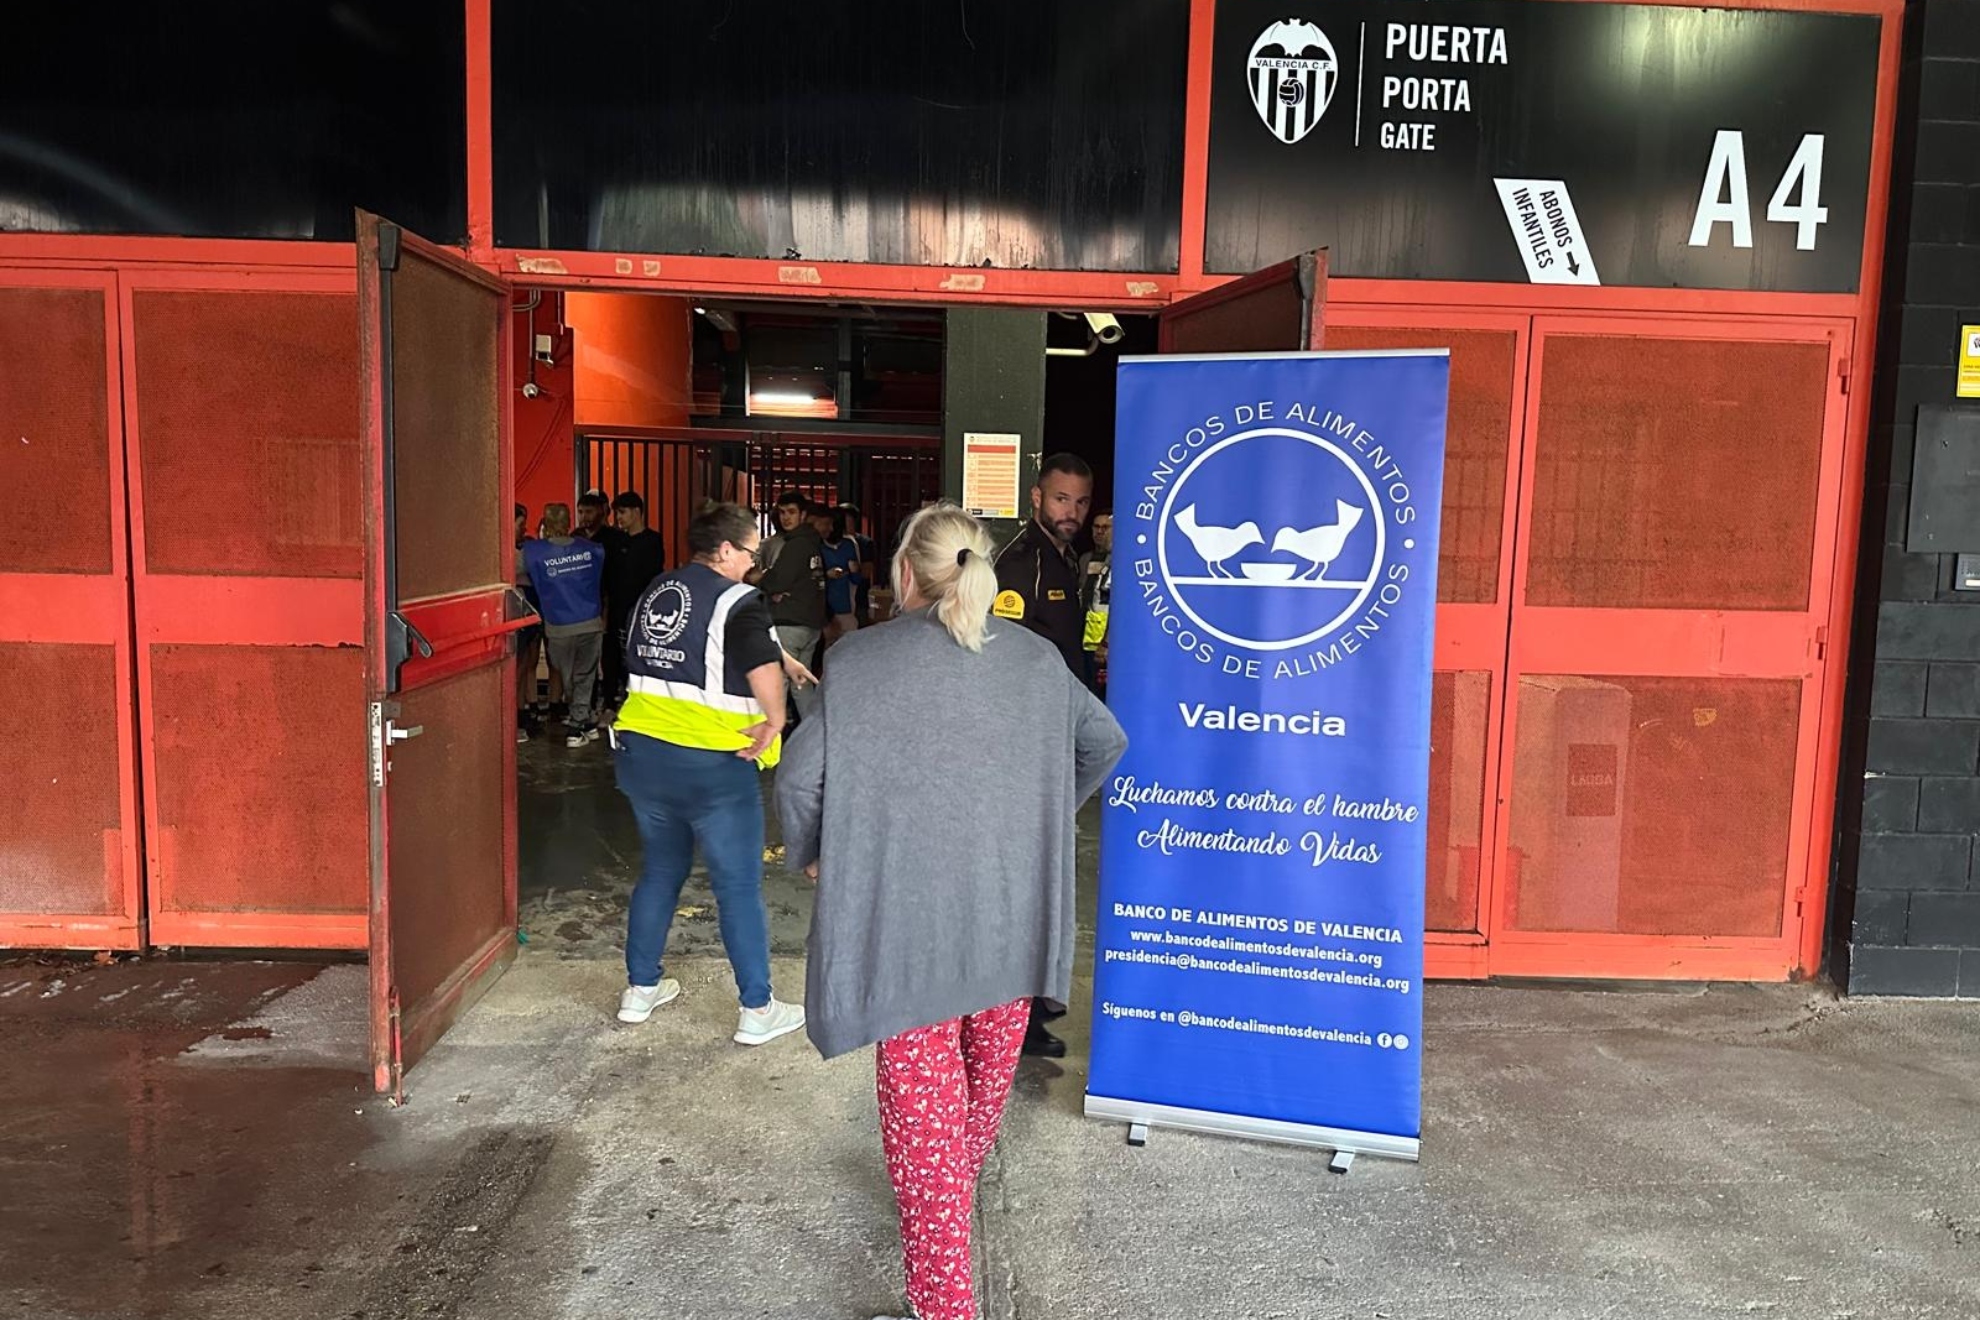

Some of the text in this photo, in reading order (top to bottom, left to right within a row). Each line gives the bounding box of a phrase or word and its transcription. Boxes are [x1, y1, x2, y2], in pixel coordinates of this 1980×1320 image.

[1255, 59, 1331, 70] VALENCIA C.F.
[1385, 22, 1509, 65] PUERTA
[1382, 76, 1472, 112] PORTA
[1380, 121, 1436, 151] GATE
[1512, 187, 1554, 269] INFANTILES
[1539, 190, 1573, 248] ABONOS
[1135, 415, 1225, 521] BANCOS
[1235, 401, 1275, 426] DE
[1285, 402, 1415, 524] ALIMENTOS
[1135, 559, 1410, 680] BANCOS DE ALIMENTOS
[1178, 702, 1346, 737] Valencia
[1108, 776, 1419, 823] Luchamos contra el hambre
[1137, 818, 1382, 867] Alimentando Vidas
[1113, 903, 1403, 944] BANCO DE ALIMENTOS DE VALENCIA
[1104, 949, 1410, 994] presidencia@bancodealimentosdevalencia.org
[1130, 930, 1383, 969] www.bancodealimentosdevalencia.org
[1102, 1002, 1157, 1022] Síguenos
[1160, 1010, 1175, 1024] en
[1178, 1010, 1372, 1046] @bancodealimentosdevalencia
